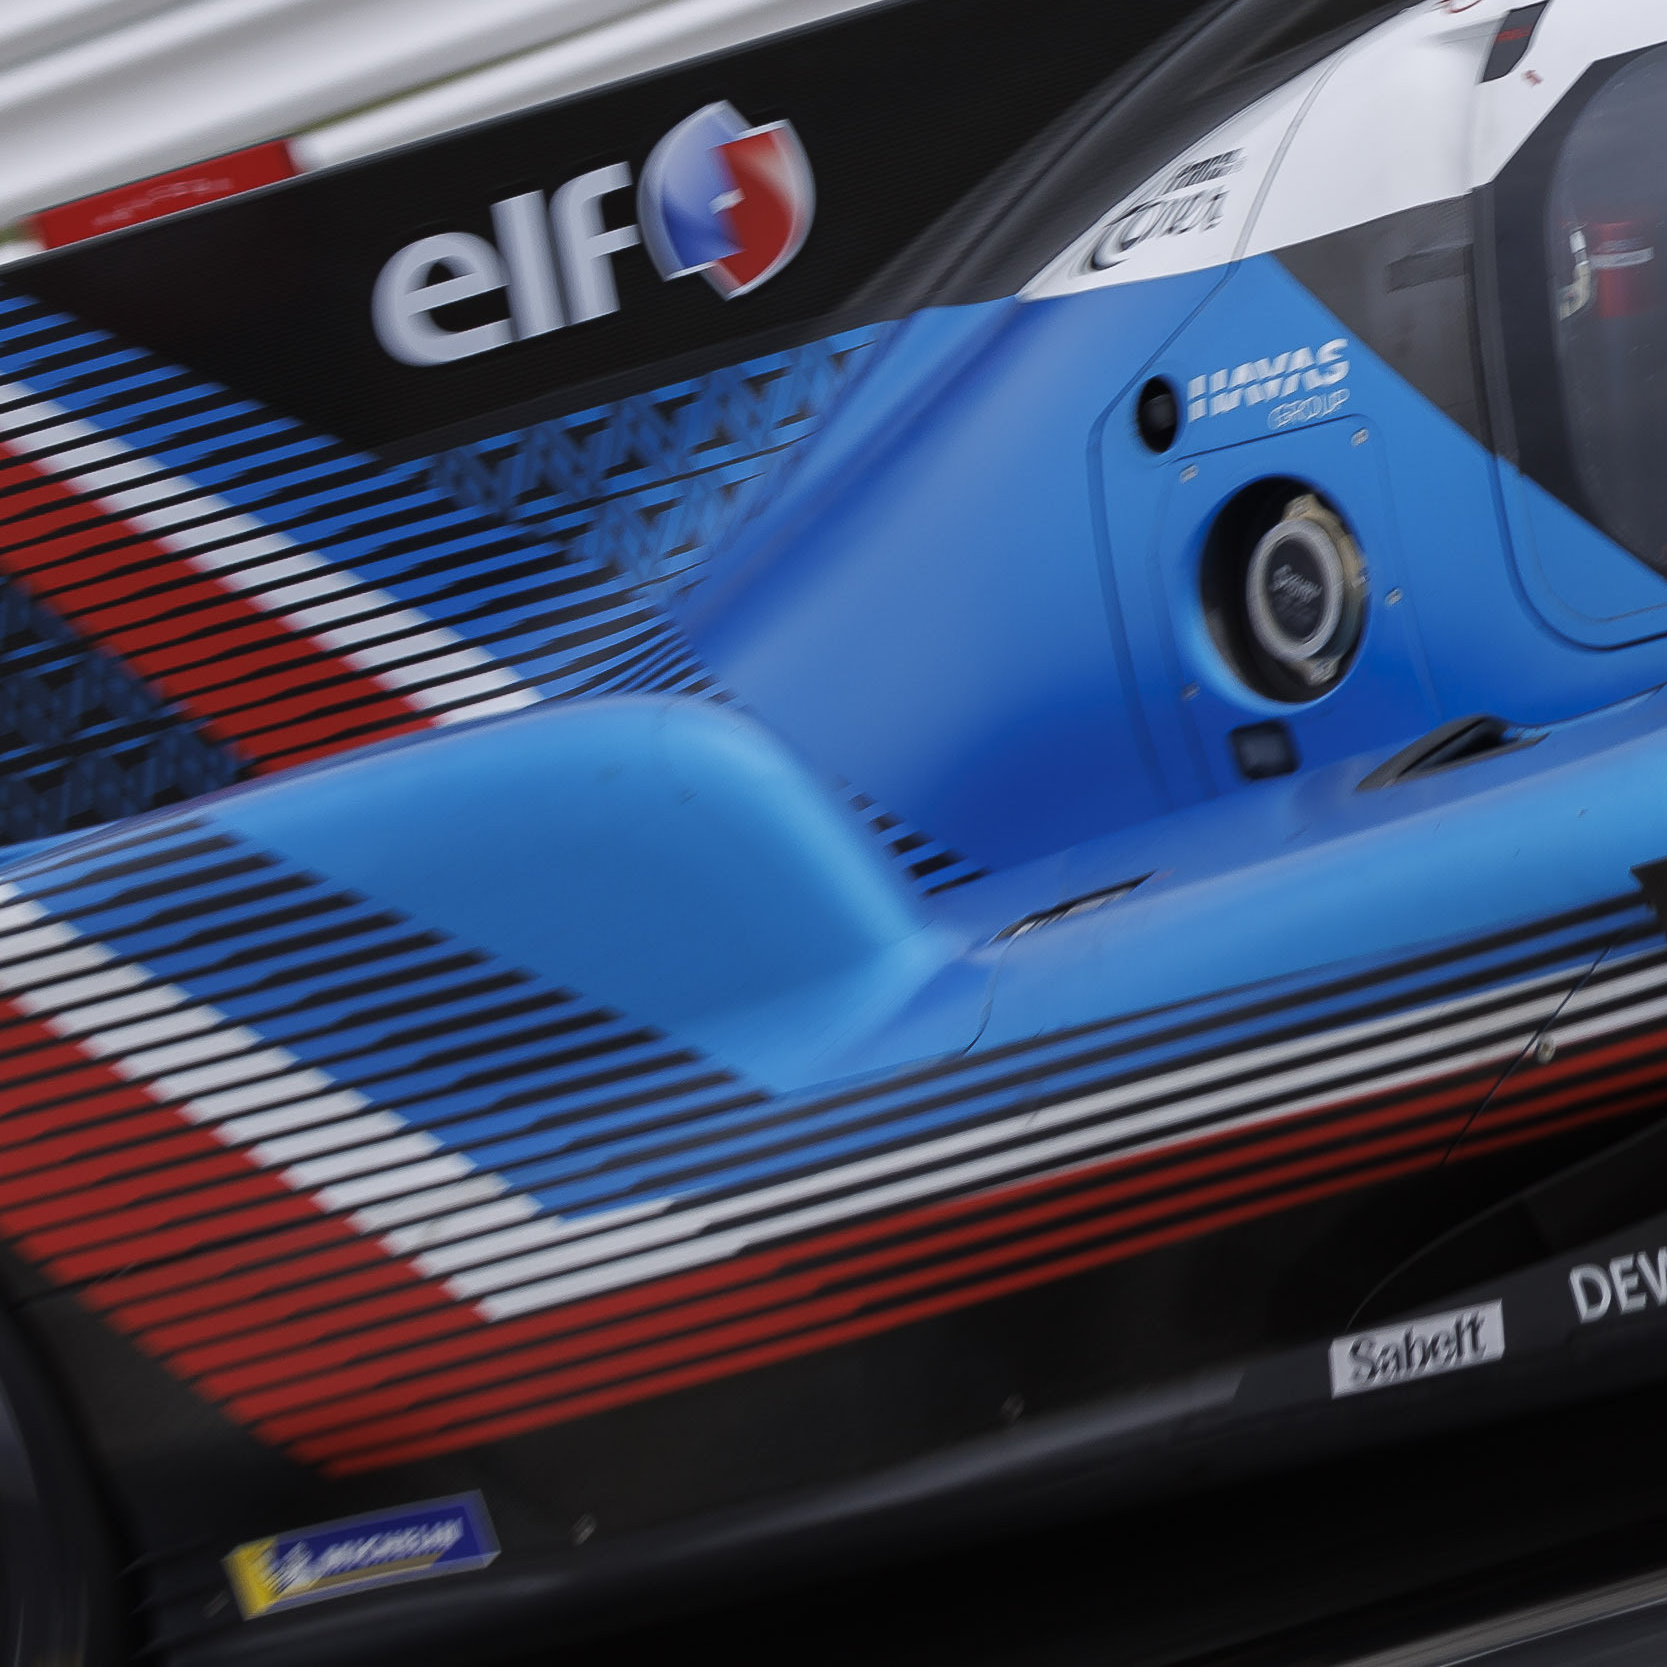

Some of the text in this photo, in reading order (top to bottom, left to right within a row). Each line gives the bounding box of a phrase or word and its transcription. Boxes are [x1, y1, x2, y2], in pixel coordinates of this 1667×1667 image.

[371, 159, 642, 368] elf
[1186, 337, 1350, 424] HAVAS
[1347, 1308, 1489, 1385] Sabelt
